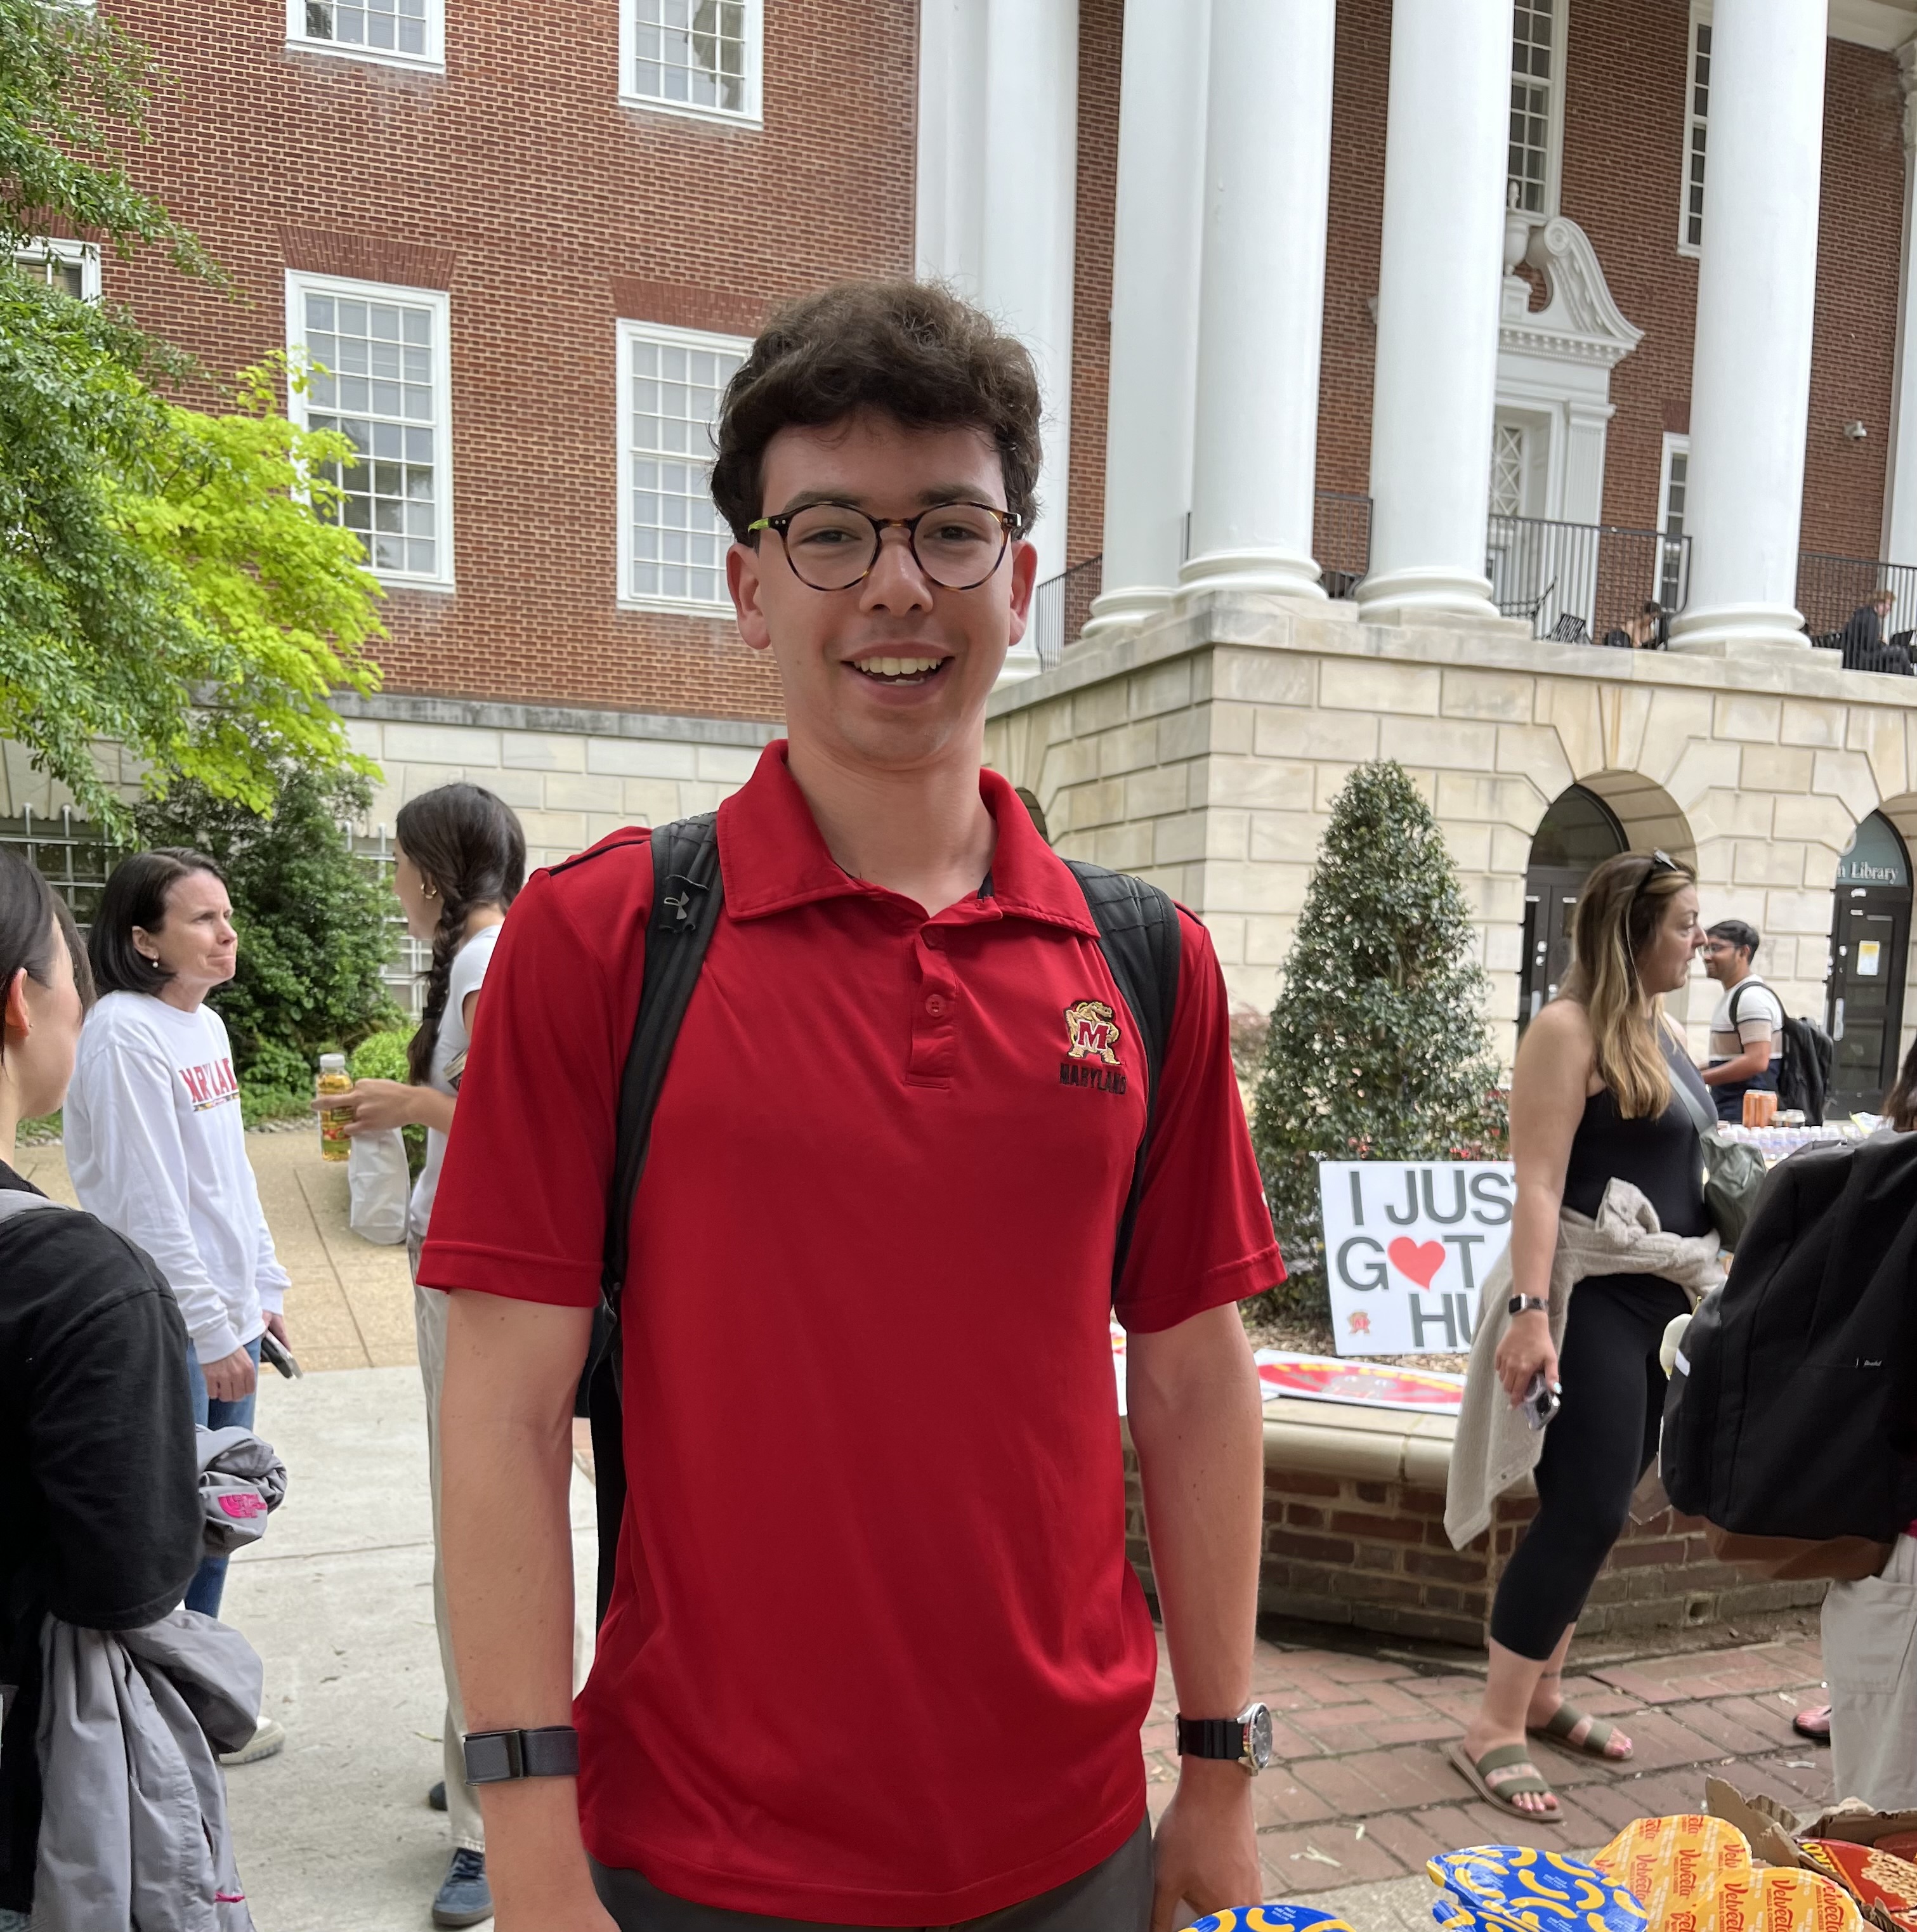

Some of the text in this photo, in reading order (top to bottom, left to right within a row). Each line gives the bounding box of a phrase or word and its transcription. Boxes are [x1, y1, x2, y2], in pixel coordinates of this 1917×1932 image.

[1852, 861, 1899, 884] Library
[1078, 1020, 1109, 1050] M
[1060, 1062, 1127, 1094] MARYLAND
[1349, 1170, 1515, 1225] I JUS
[1724, 1844, 1745, 1869] Velv
[1679, 1850, 1701, 1897] Velveeta
[1724, 1883, 1748, 1932] Velveet
